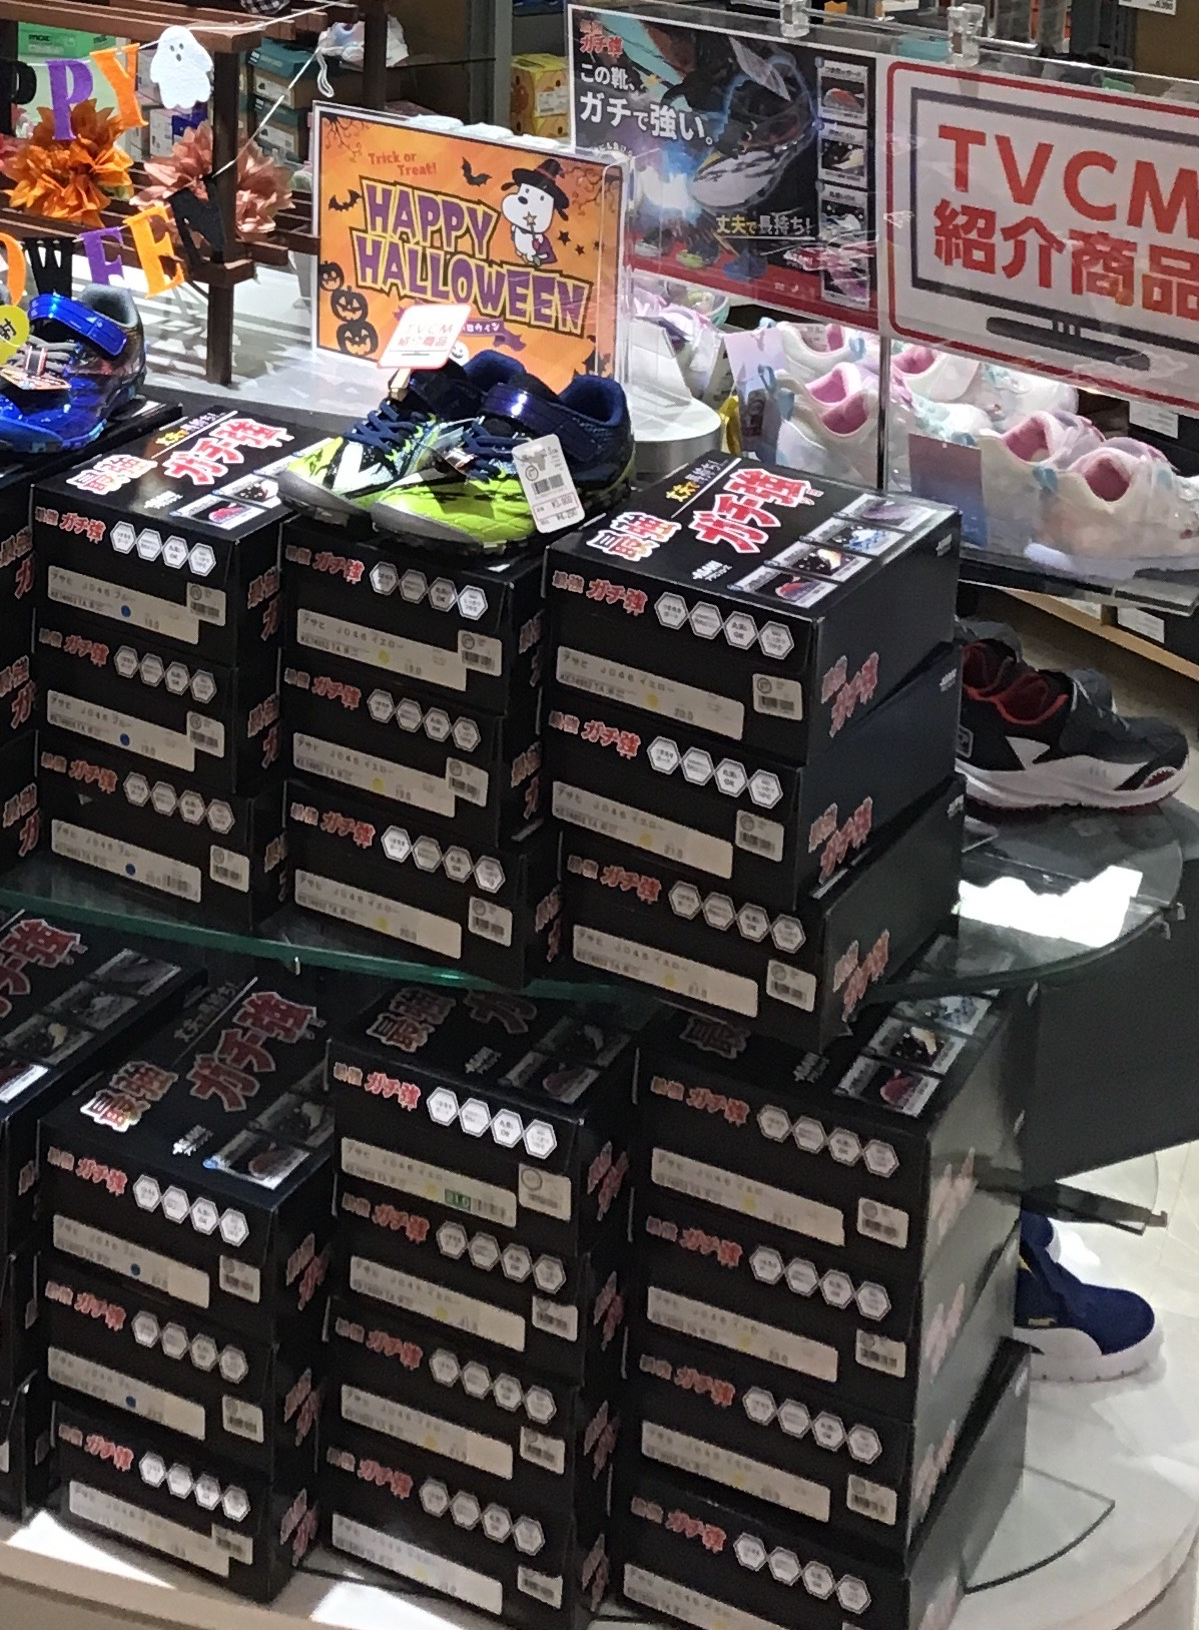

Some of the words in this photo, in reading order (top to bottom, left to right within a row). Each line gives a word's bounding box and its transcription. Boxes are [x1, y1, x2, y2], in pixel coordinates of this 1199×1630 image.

[580, 62, 637, 92] この靴、
[580, 91, 714, 146] ガチで強い。
[368, 151, 401, 166] Trick
[403, 153, 417, 163] or
[396, 163, 437, 177] Treat!
[938, 125, 1199, 241] TVCM
[360, 178, 498, 258] HAPPY
[716, 215, 812, 235] 丈夫で長持ち!
[934, 199, 1199, 321] 紹介商品
[352, 230, 592, 335] HALLOWEEN
[462, 321, 500, 333] ロウィン
[66, 453, 159, 496] 最強
[161, 418, 296, 486] ガチ強
[59, 512, 106, 545] ガチ強
[585, 510, 682, 562] 最強
[688, 467, 824, 554] ガチ強
[312, 551, 365, 585] ガチ強
[586, 578, 648, 616] ガチ強
[64, 633, 109, 667] ガチ強
[311, 676, 362, 710] ガチ強
[581, 720, 641, 760] ガチ強
[68, 758, 118, 793] ガチ強
[320, 811, 375, 849] ガチ強
[600, 865, 662, 903] ガチ強
[186, 990, 329, 1112] ガチ強
[363, 1071, 421, 1111] ガチ強
[372, 1203, 430, 1244] ガチ強
